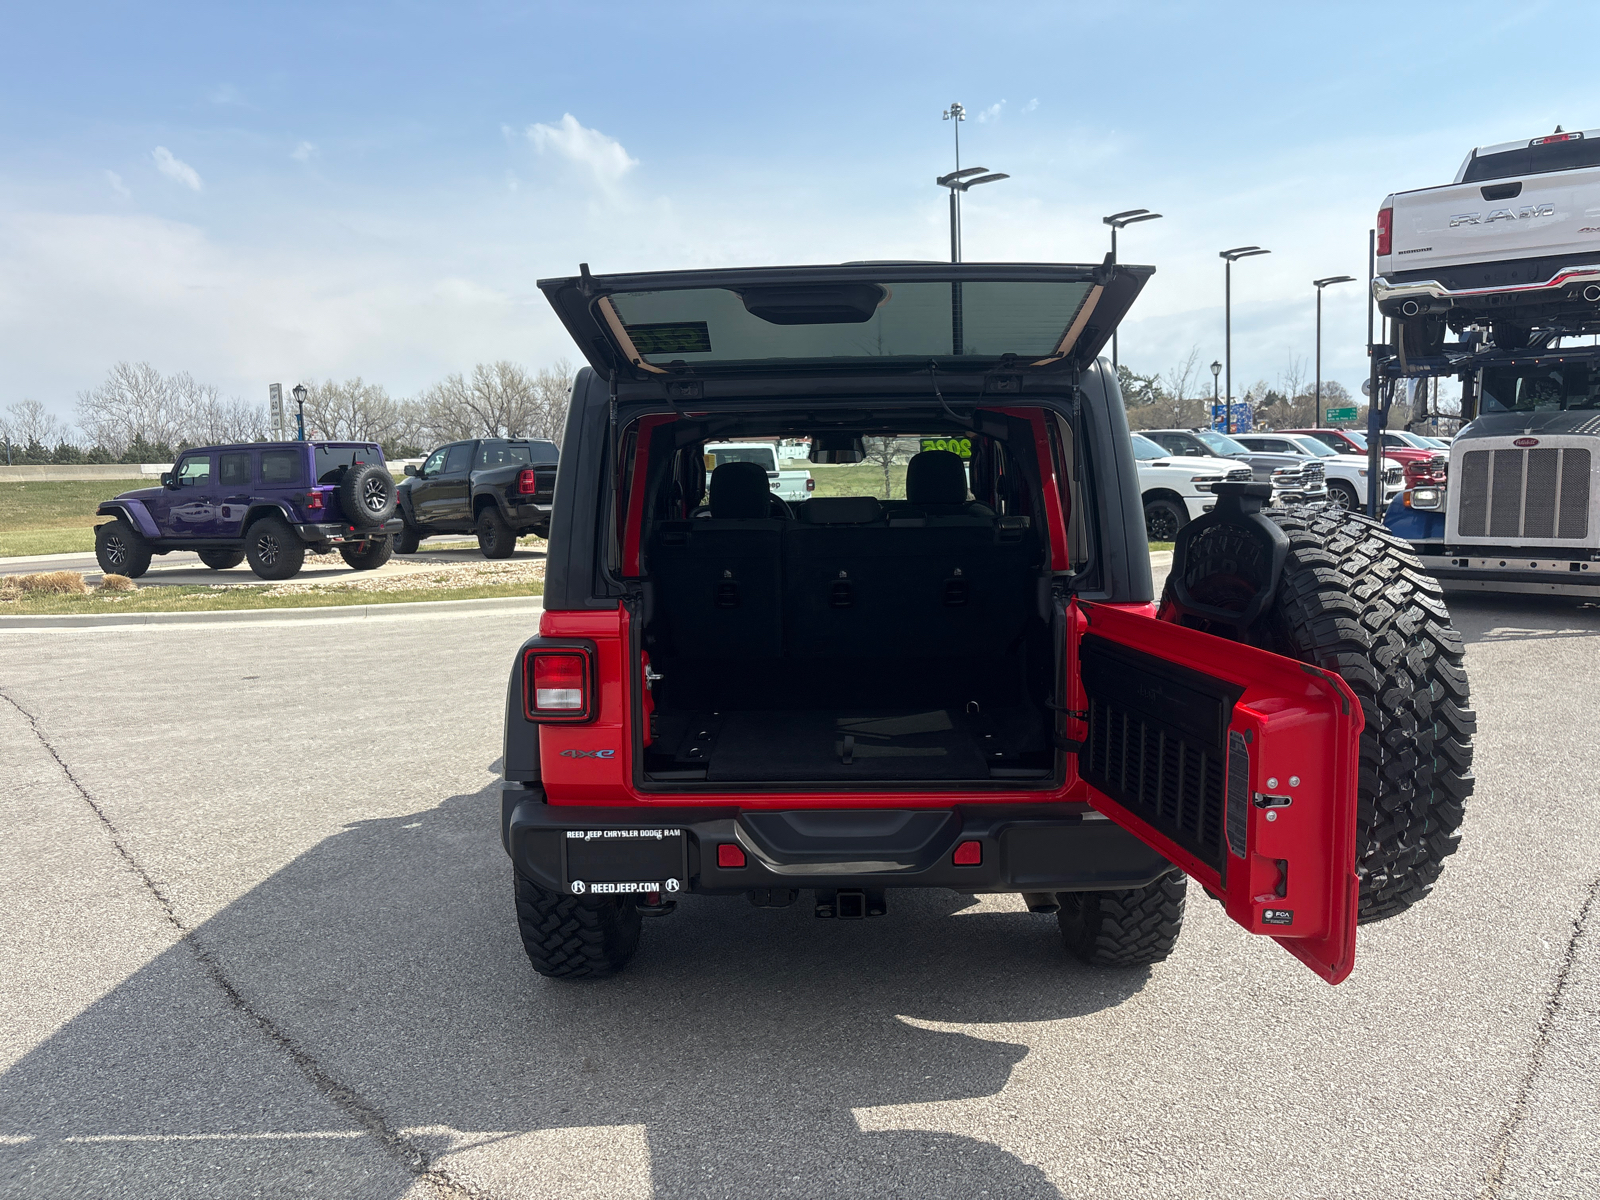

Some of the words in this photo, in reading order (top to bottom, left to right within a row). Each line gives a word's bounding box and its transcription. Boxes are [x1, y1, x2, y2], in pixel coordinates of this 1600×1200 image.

[1449, 203, 1555, 228] RAM
[559, 749, 615, 759] 4xe
[587, 830, 602, 838] JEEP
[603, 830, 639, 838] CHRYSLER
[640, 829, 662, 837] DODGE
[591, 882, 660, 893] REEDJEEP.COM
